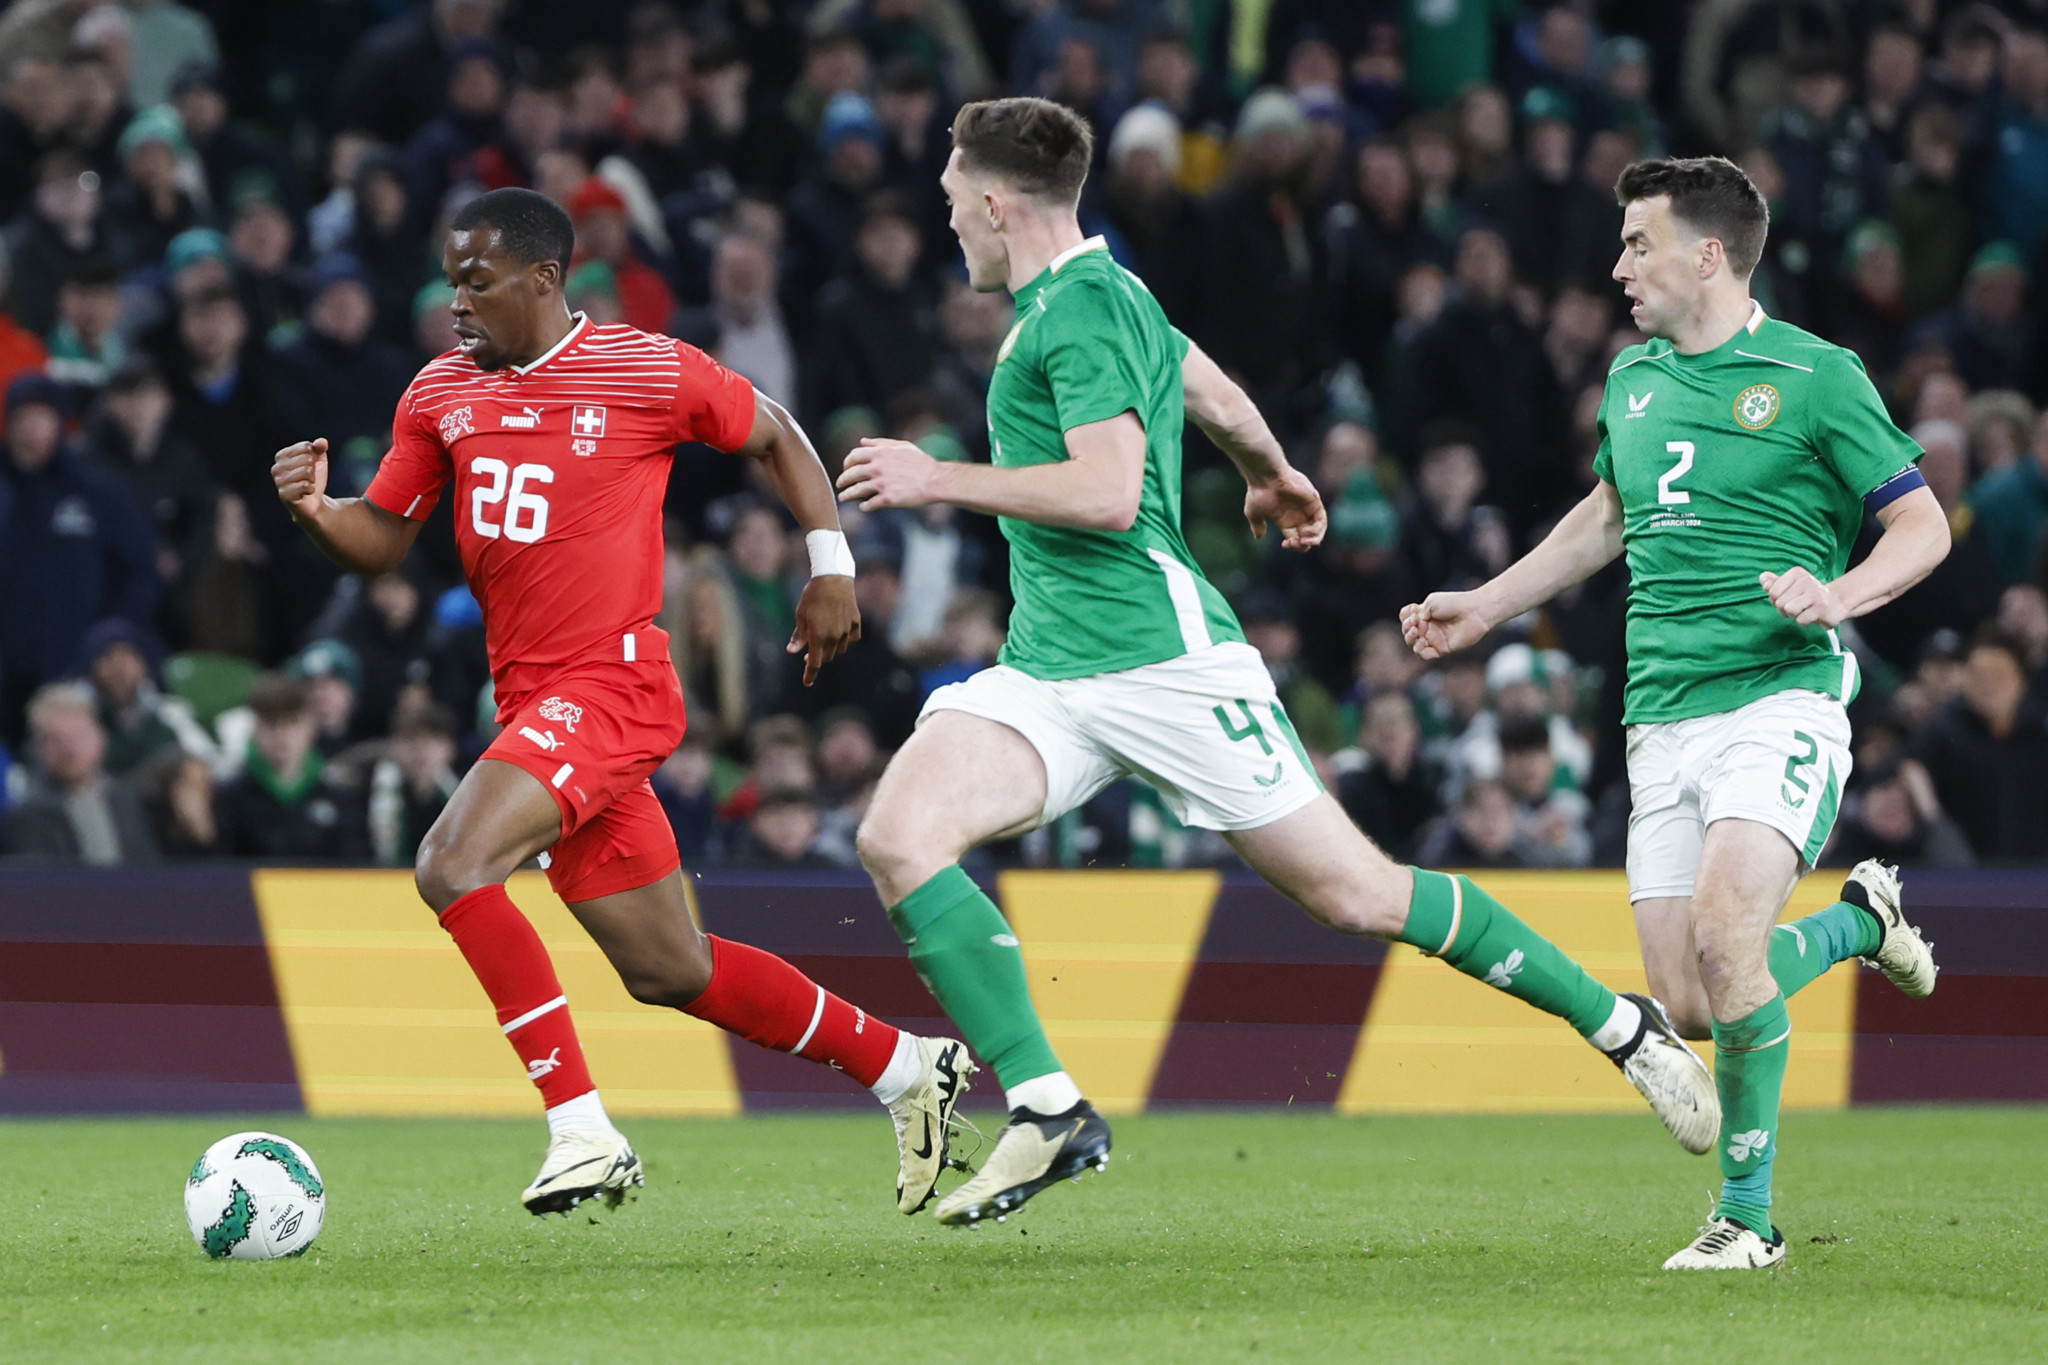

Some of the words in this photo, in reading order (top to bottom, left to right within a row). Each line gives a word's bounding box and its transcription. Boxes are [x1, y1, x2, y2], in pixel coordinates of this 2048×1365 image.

[1741, 387, 1776, 400] IRELAND
[501, 415, 535, 428] PUMA
[1658, 441, 1695, 504] 2
[470, 456, 555, 544] 26
[1661, 519, 1685, 527] MARCH
[1685, 519, 1702, 527] 2024
[518, 726, 552, 750] PUMA
[1212, 698, 1274, 757] 4
[1784, 729, 1818, 795] 2
[270, 1204, 294, 1231] umbro
